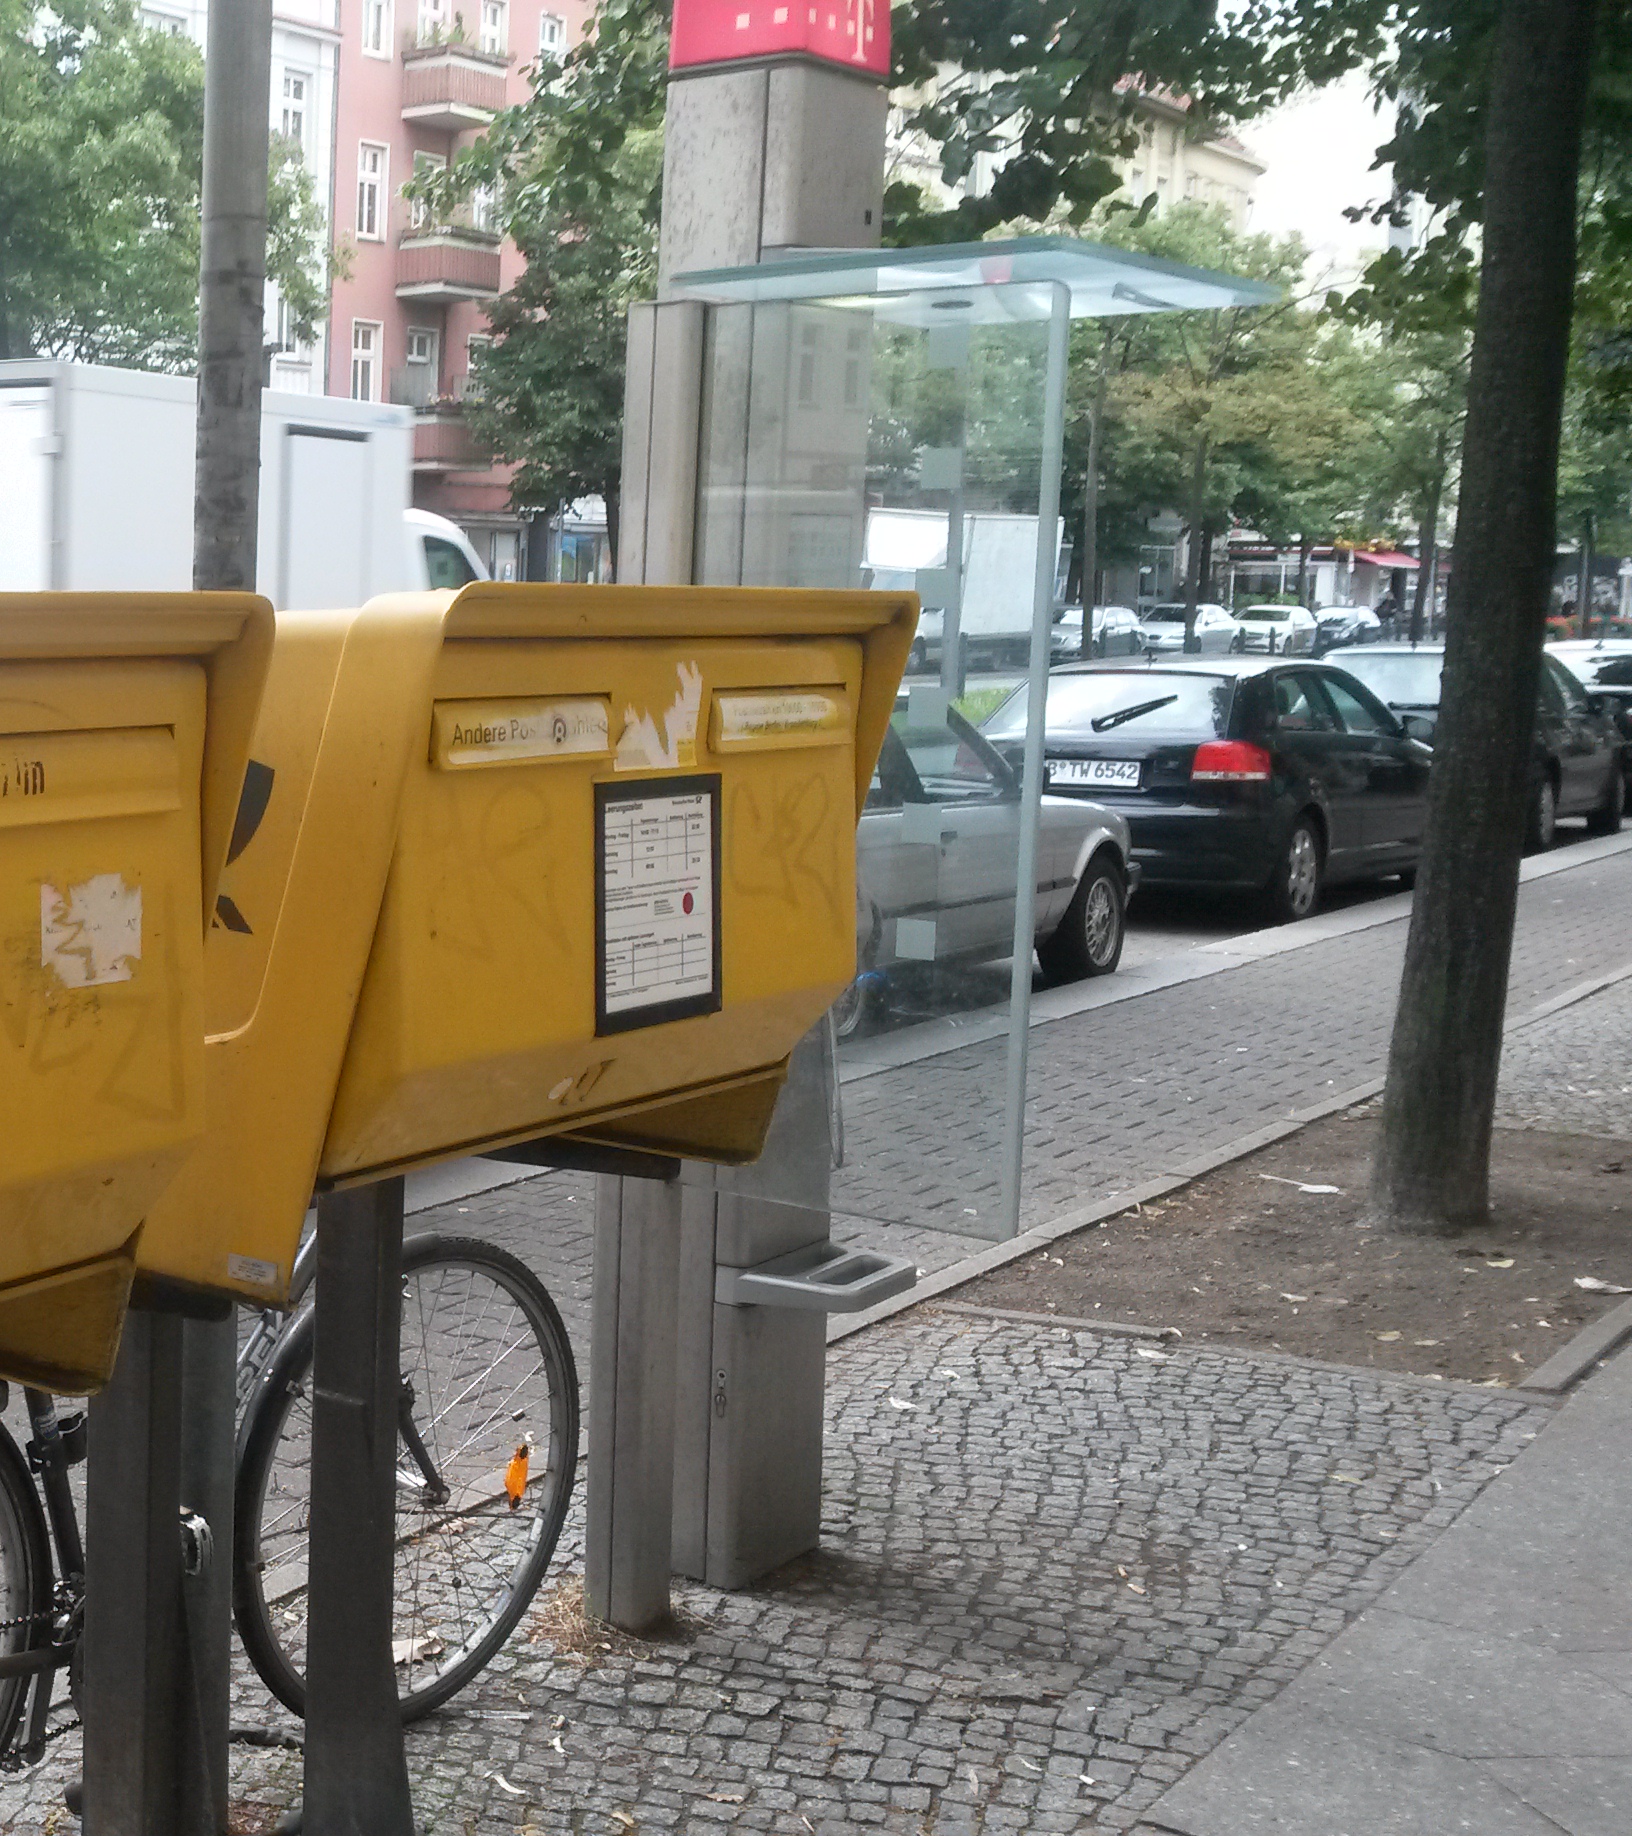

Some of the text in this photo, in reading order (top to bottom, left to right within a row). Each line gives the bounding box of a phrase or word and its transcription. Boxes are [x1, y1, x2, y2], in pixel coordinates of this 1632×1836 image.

[453, 721, 506, 746] Andere
[1070, 762, 1091, 777] TW
[1094, 762, 1138, 779] 6542
